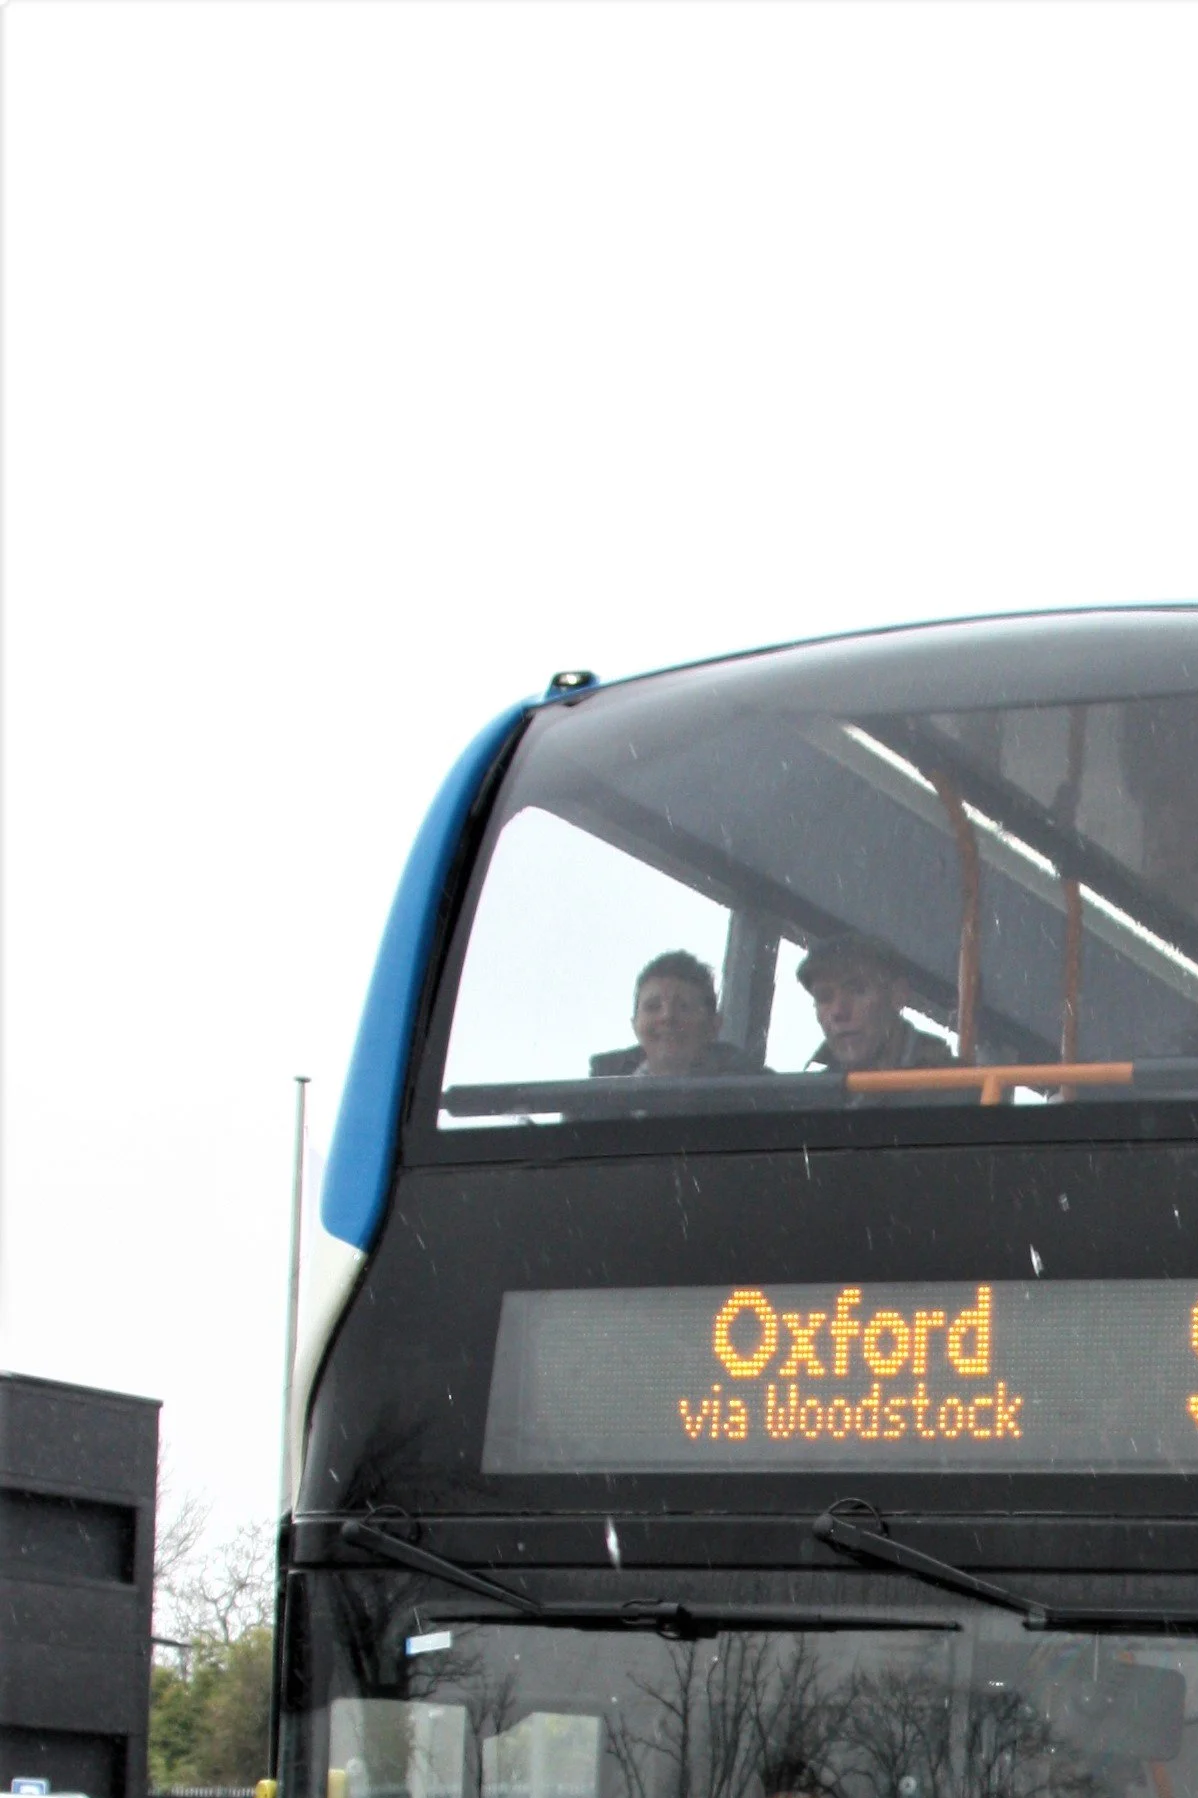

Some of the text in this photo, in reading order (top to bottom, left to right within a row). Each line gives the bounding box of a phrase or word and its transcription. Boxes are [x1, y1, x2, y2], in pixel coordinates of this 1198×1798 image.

[713, 1285, 992, 1378] Oxford
[679, 1382, 1023, 1440] via Woodstock
